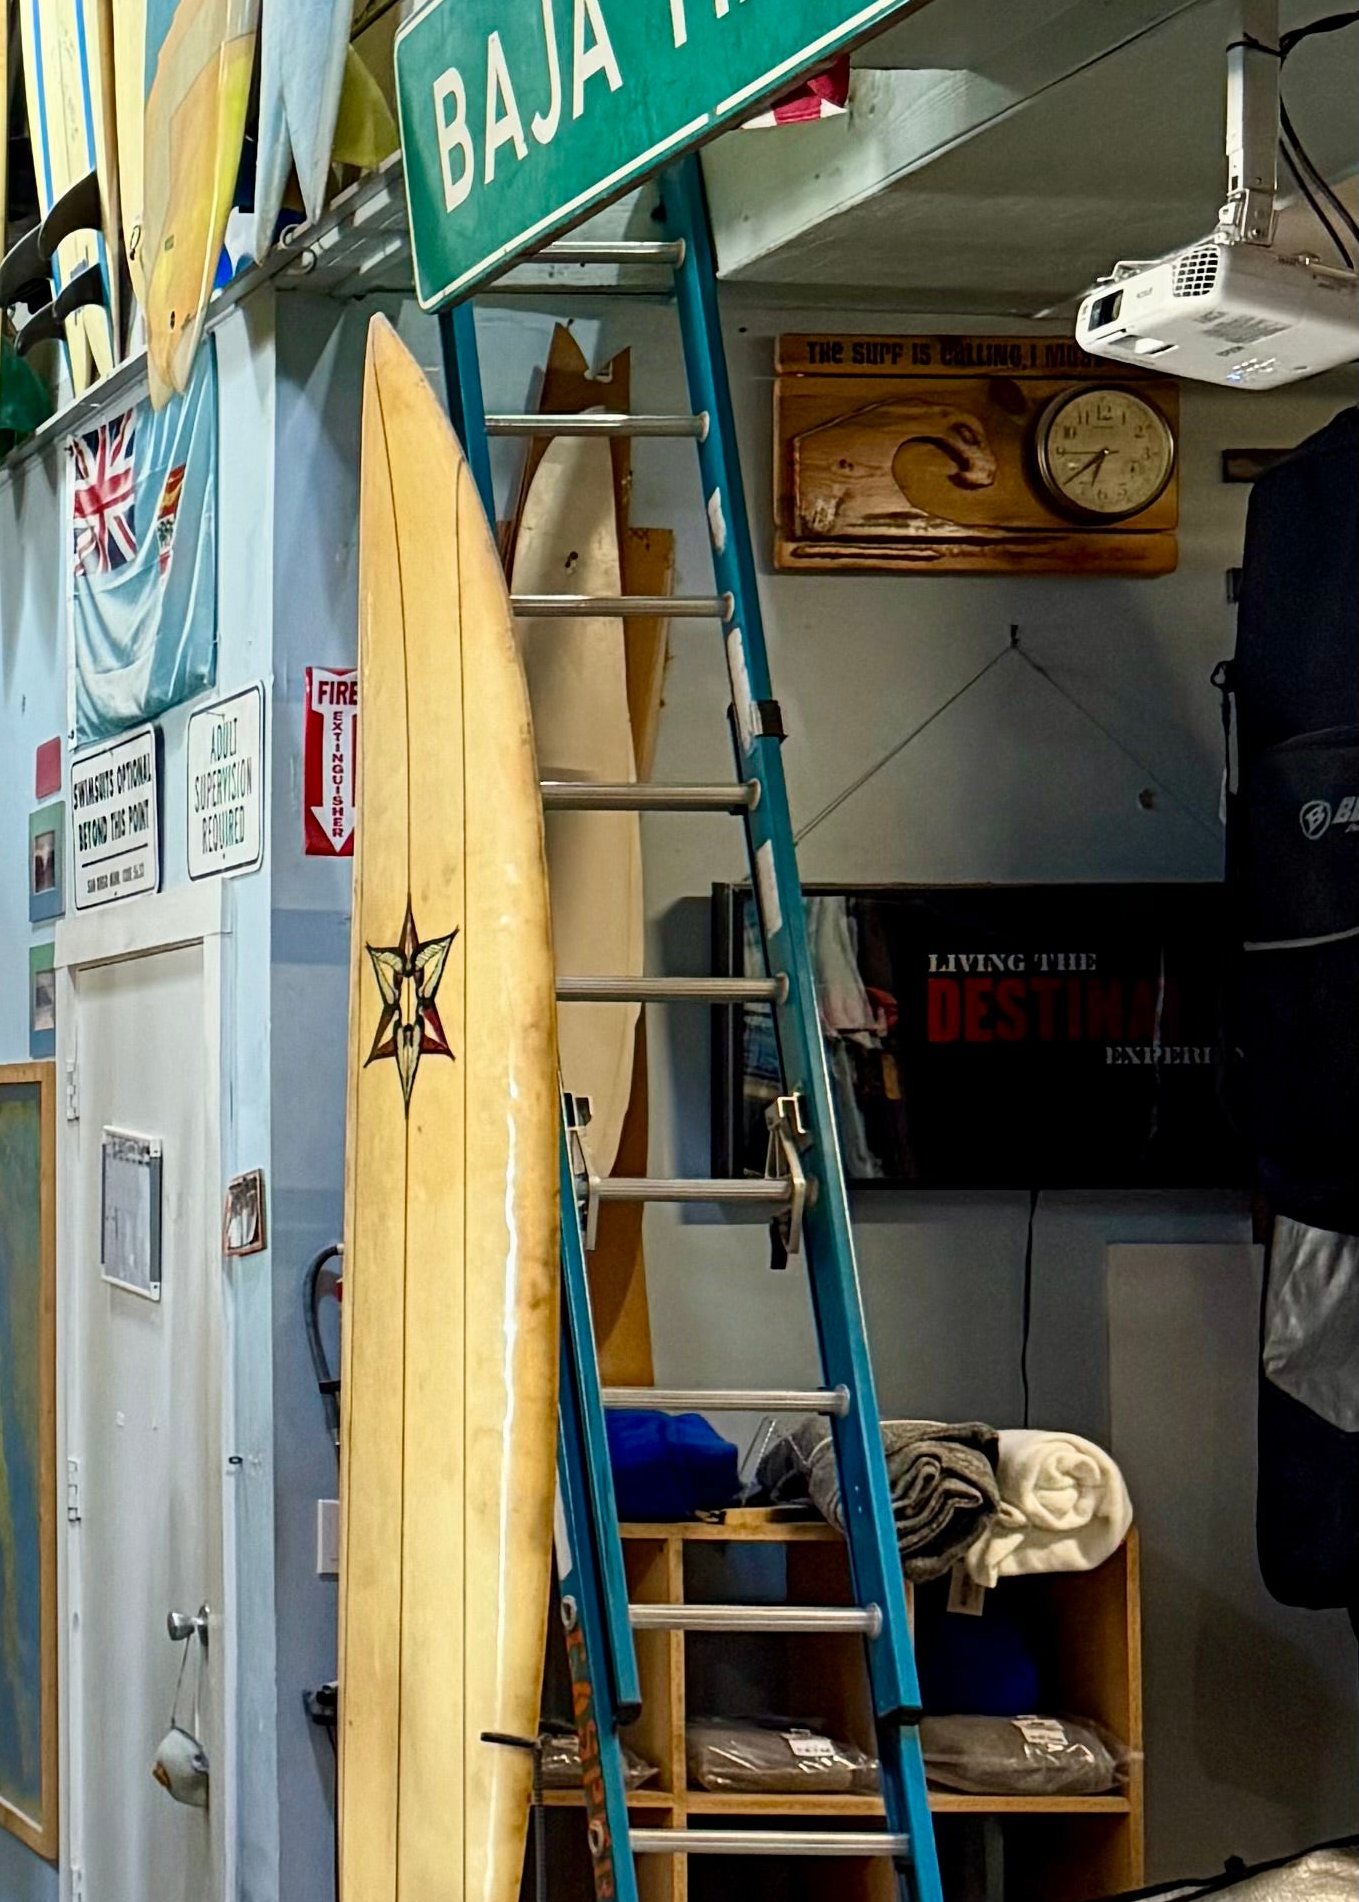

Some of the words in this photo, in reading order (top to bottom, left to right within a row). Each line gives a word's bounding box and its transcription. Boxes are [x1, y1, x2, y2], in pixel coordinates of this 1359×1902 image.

[912, 342, 931, 365] IS
[1045, 343, 1106, 369] MUS
[318, 680, 358, 705] FIRE
[210, 718, 238, 763] ADULT
[73, 769, 114, 810] SWIMSUITS
[117, 753, 151, 794] OPTIONAL
[194, 757, 253, 813] SUPERVISION
[332, 711, 344, 838] EXTINGUISHER
[79, 816, 108, 851] BEYOND
[111, 808, 125, 841] THIS
[128, 799, 149, 835] POINT
[202, 805, 245, 854] REQUIRED
[927, 954, 1026, 973] LIVING
[1034, 954, 1097, 972] THE
[927, 977, 1181, 1043] DESTINA
